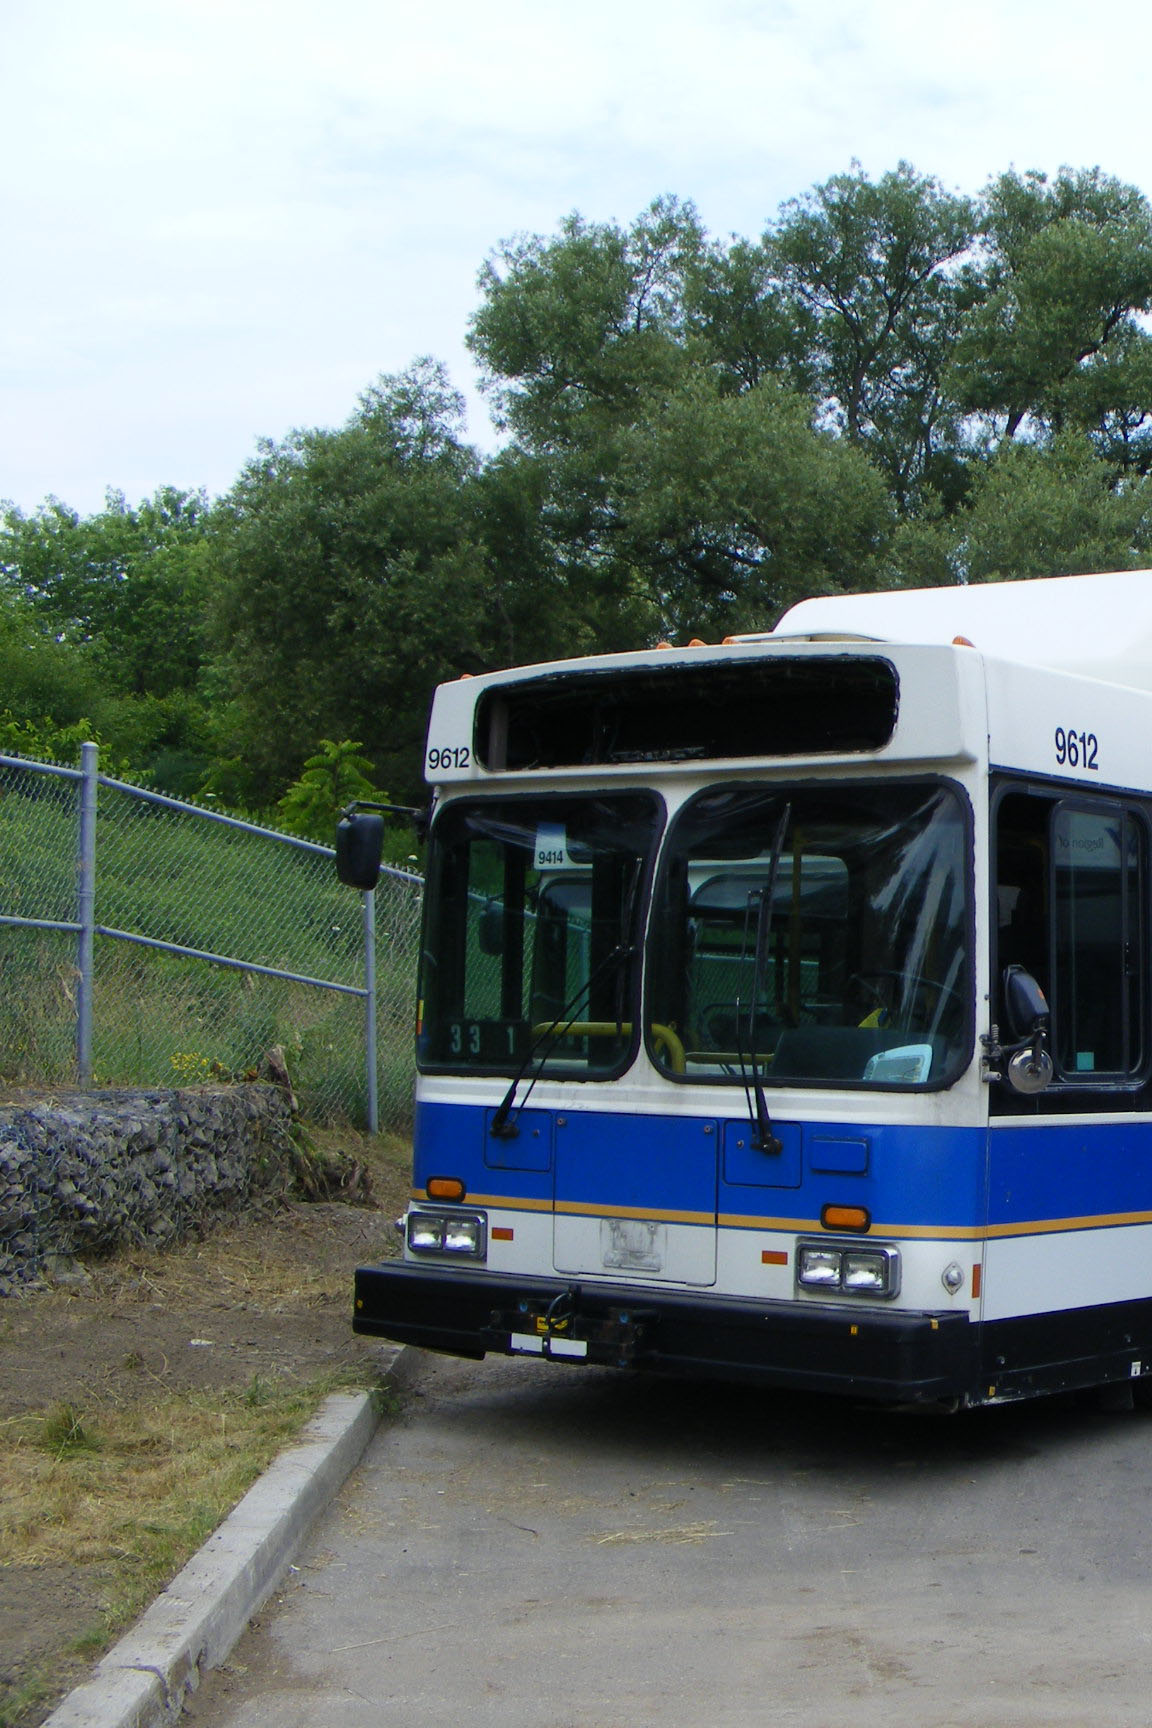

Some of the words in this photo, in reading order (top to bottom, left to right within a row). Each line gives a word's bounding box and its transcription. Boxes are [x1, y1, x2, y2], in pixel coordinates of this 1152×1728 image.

[428, 747, 470, 769] 9612
[1055, 727, 1099, 770] 9612
[538, 850, 564, 865] 9414
